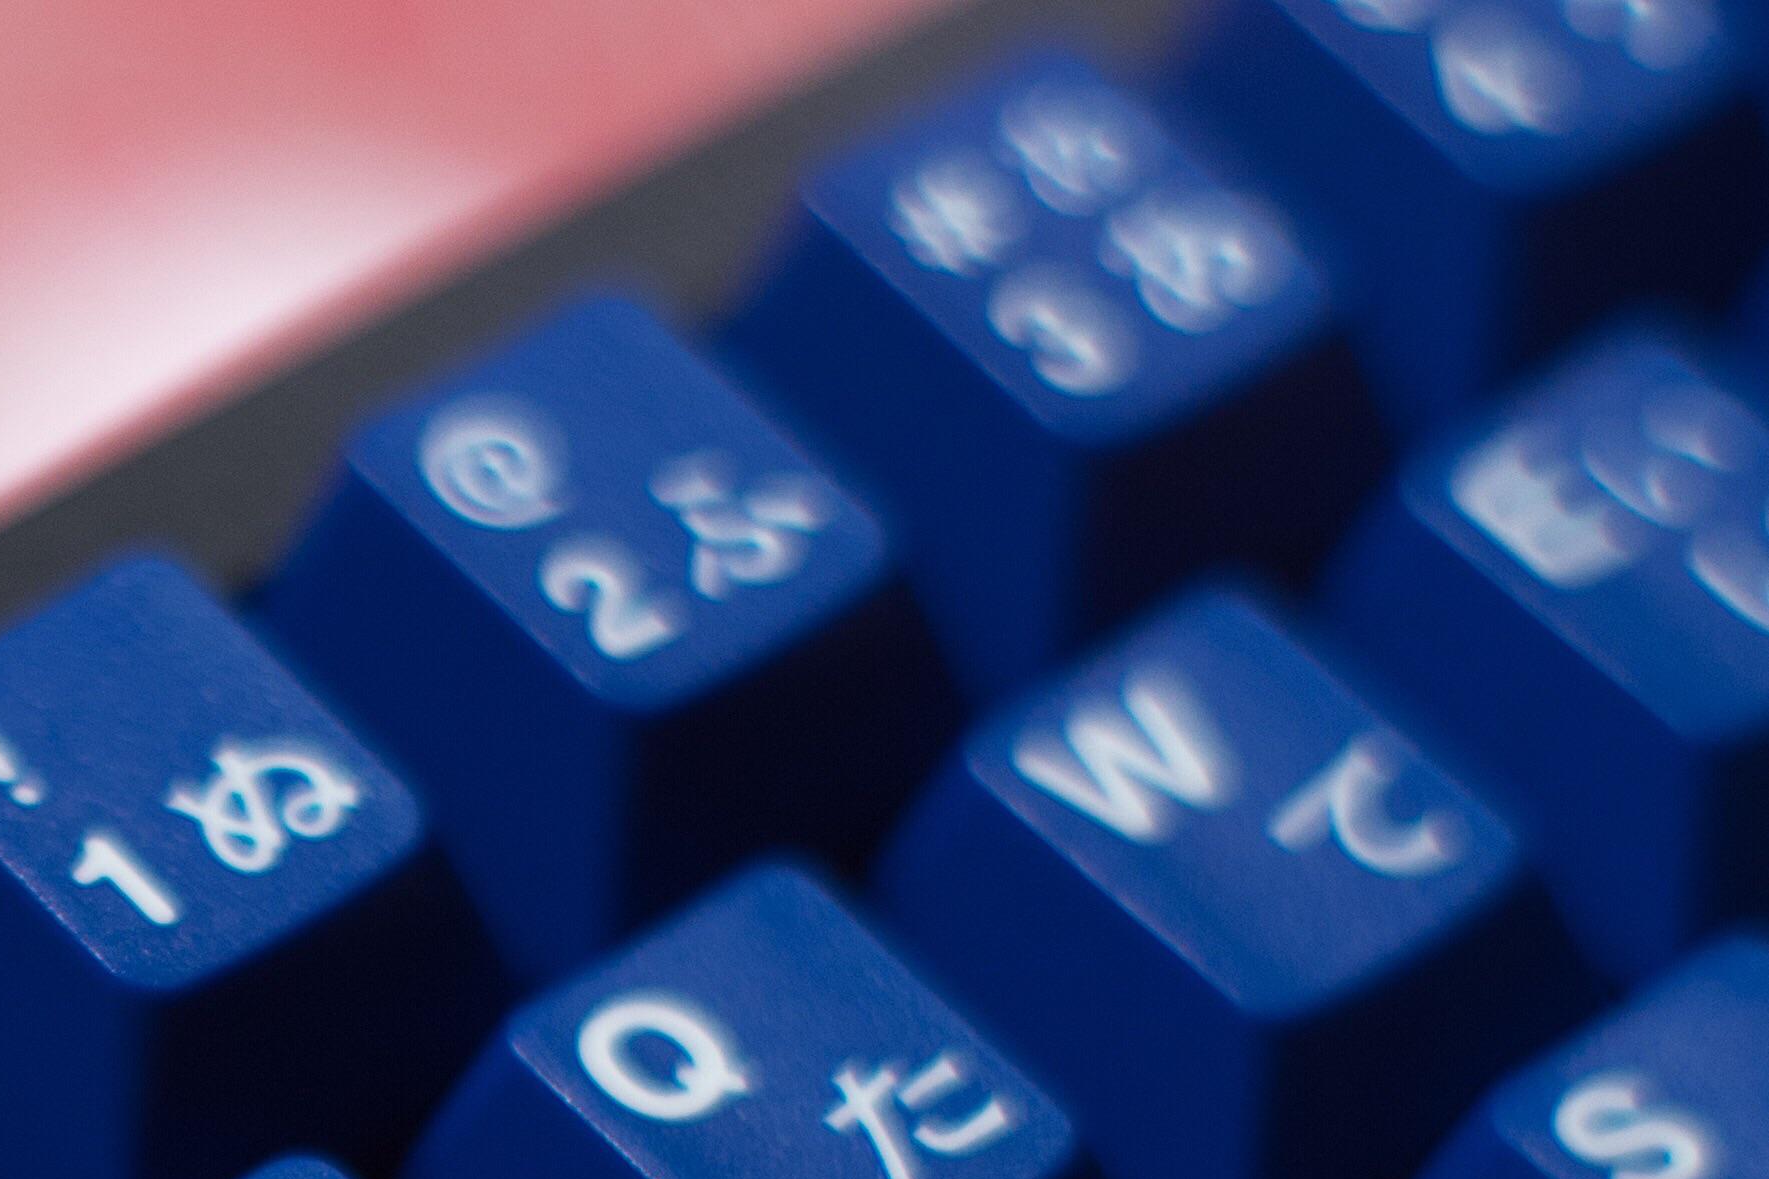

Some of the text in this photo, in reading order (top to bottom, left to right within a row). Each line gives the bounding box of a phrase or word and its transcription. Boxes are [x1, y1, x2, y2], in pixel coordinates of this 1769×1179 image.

[987, 266, 1129, 395] 3
[419, 407, 562, 528] @
[541, 452, 826, 658] 2 ふ
[73, 742, 360, 924] 1 ぬ
[1017, 672, 1456, 874] W て
[579, 996, 752, 1121] Q
